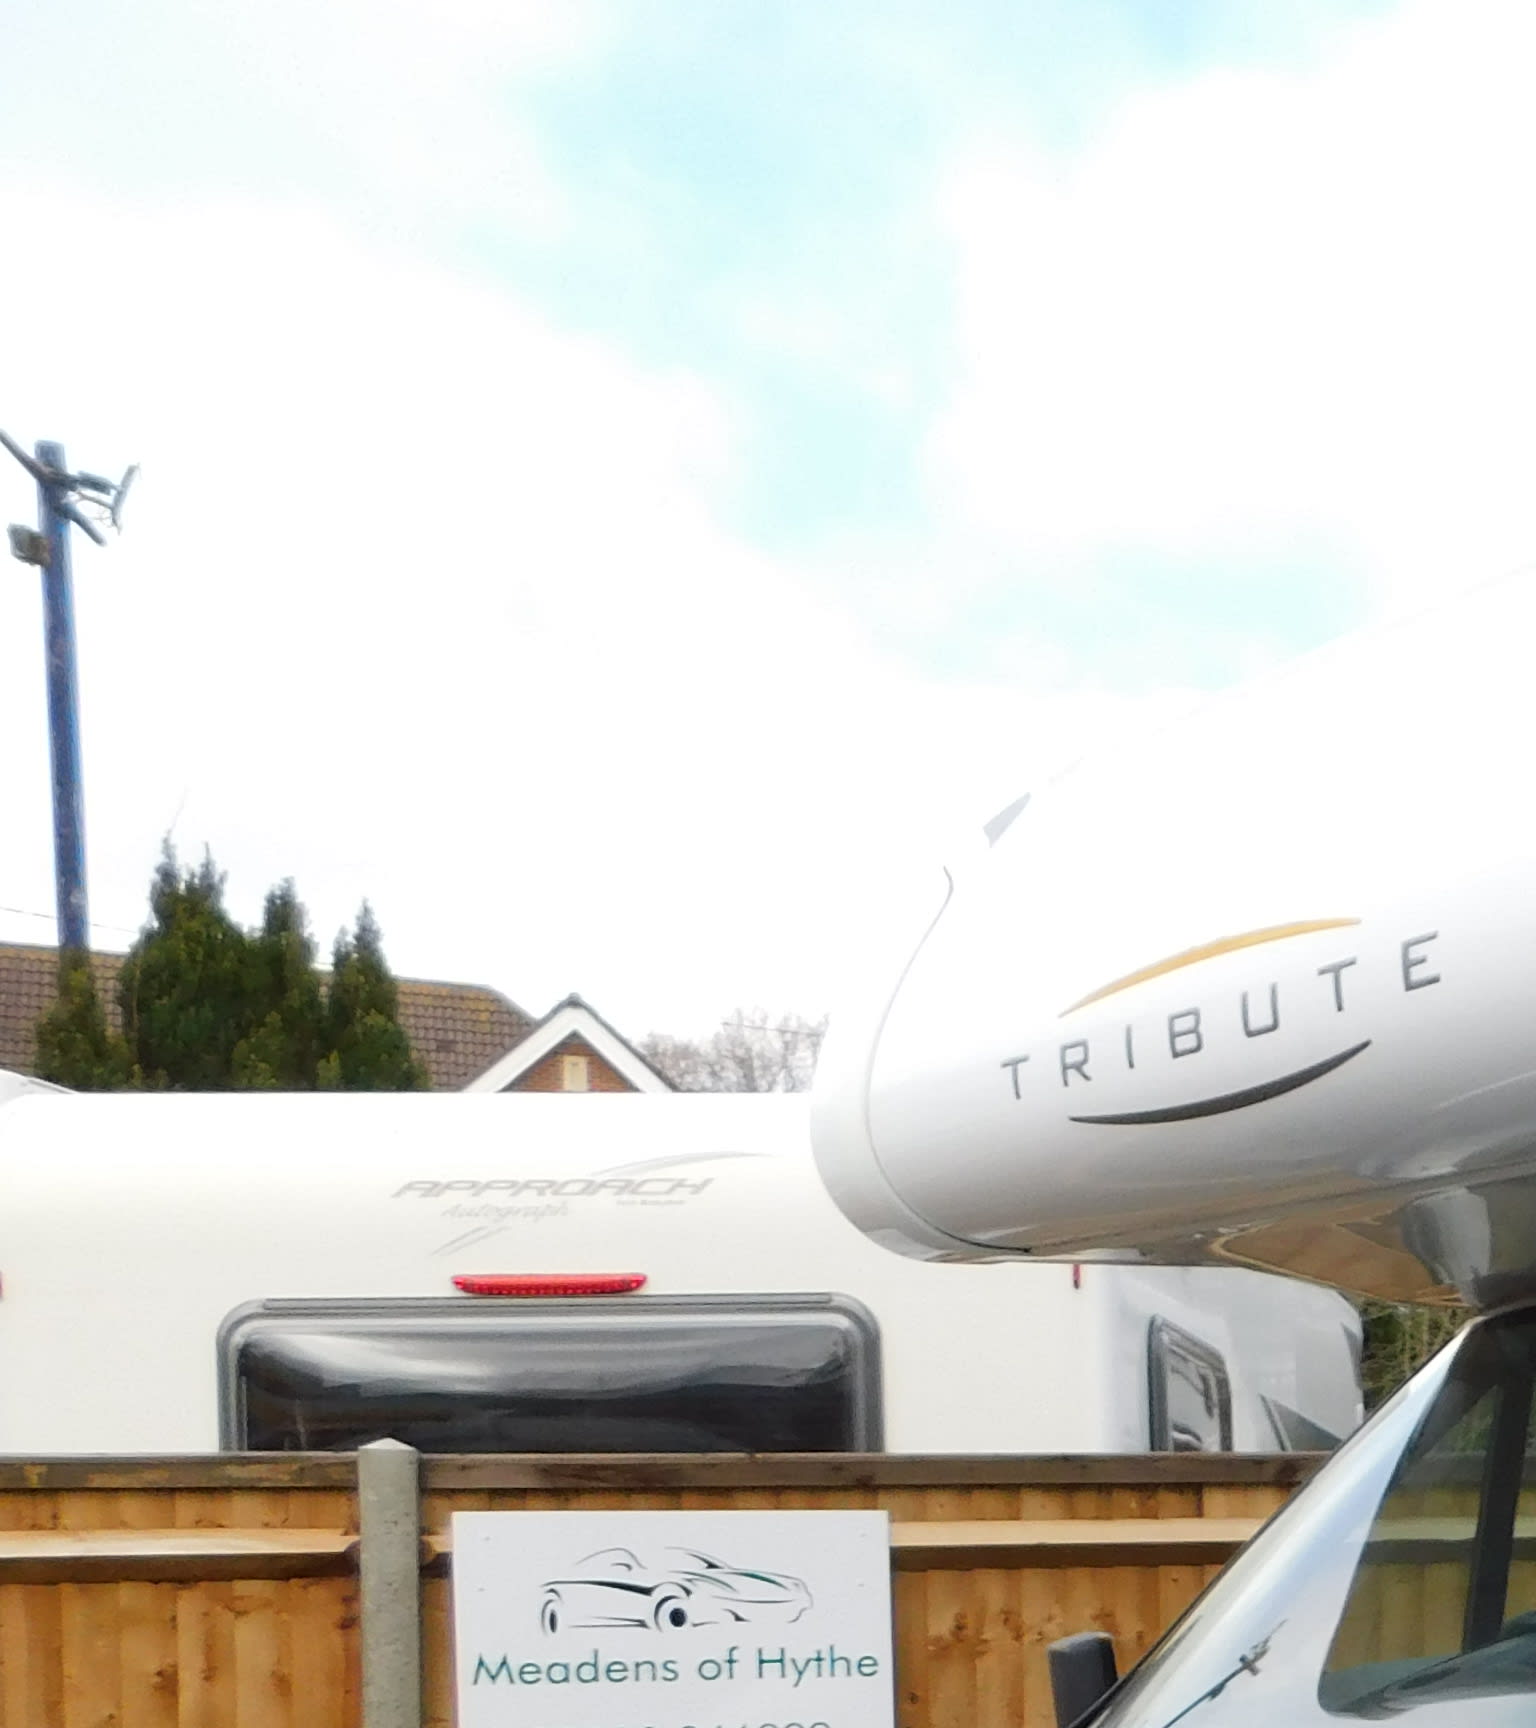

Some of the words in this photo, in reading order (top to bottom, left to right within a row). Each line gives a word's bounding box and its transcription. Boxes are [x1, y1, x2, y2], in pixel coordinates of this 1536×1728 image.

[1000, 930, 1442, 1101] TRIBUTE
[391, 1176, 716, 1199] APPROACH
[472, 1648, 680, 1686] Meadens
[698, 1645, 740, 1682] of
[755, 1644, 881, 1688] Hythe
